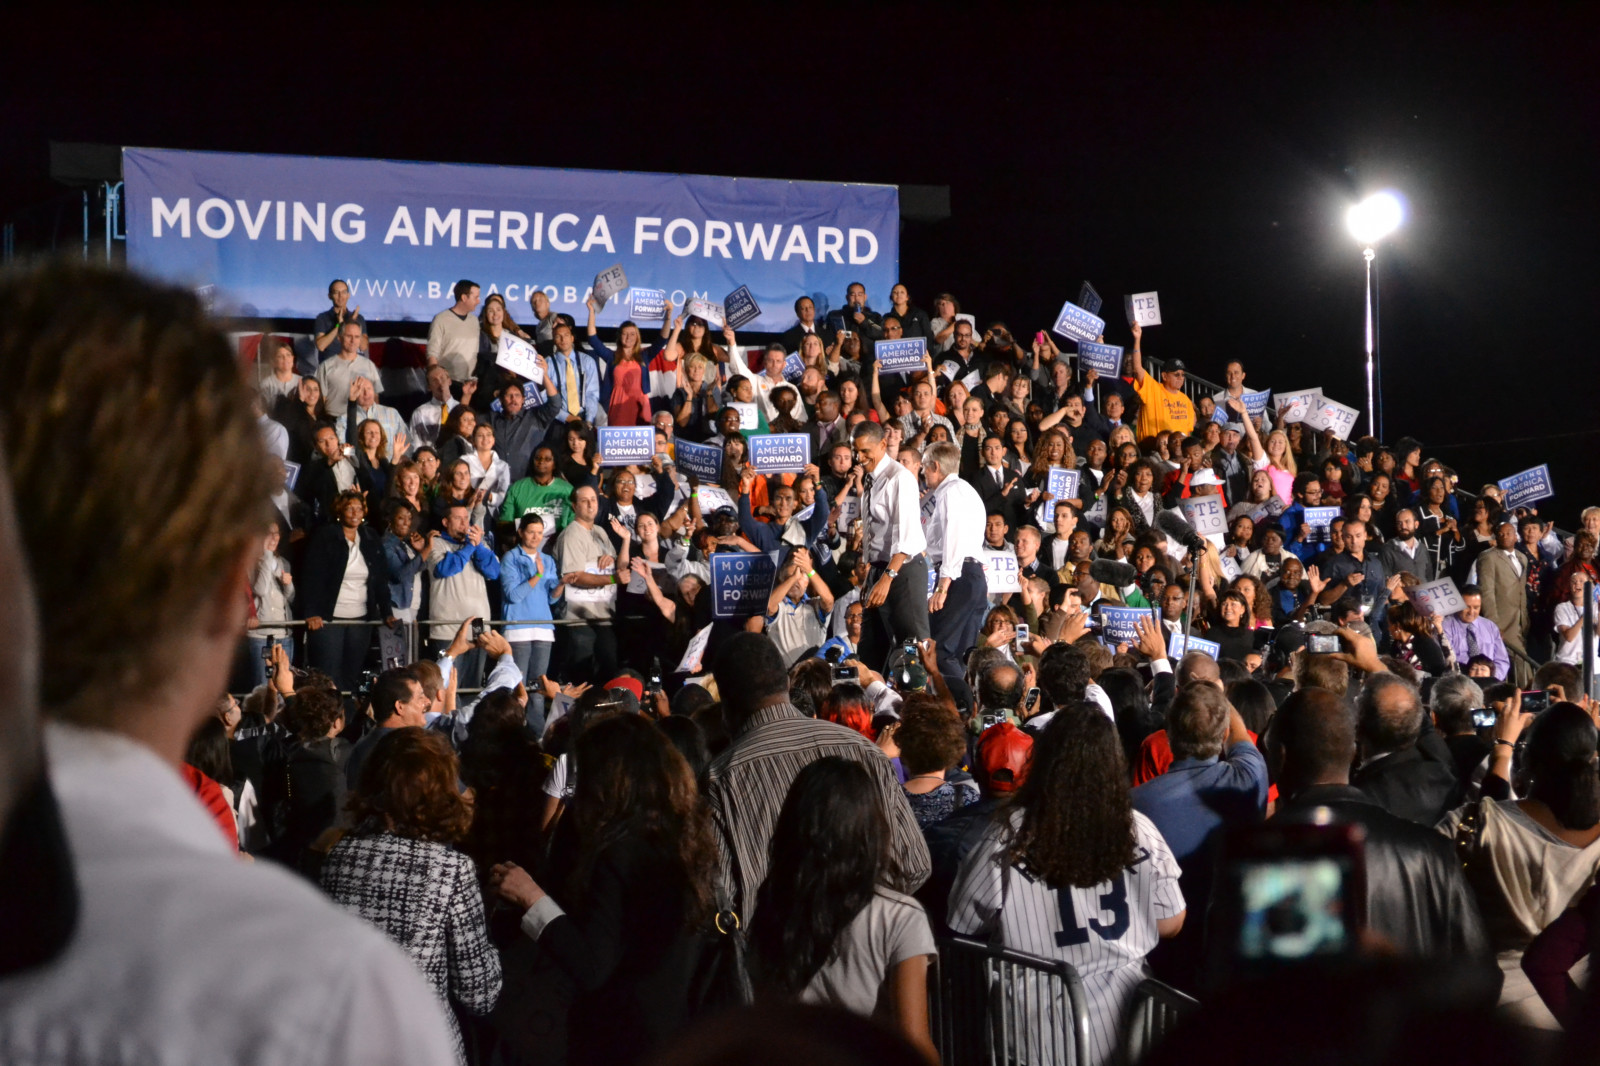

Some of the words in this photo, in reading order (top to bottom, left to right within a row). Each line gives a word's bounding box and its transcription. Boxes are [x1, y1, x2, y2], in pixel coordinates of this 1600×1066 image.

[151, 197, 366, 244] MOVING
[383, 205, 616, 254] AMERICA
[633, 216, 879, 265] FORWARD
[1134, 297, 1155, 310] TE
[728, 304, 752, 322] ORWARD
[1068, 307, 1101, 328] MOVING
[1139, 310, 1156, 321] 10
[1061, 321, 1096, 342] FORWARD
[1065, 314, 1099, 335] AMERICA
[881, 341, 920, 350] MOVING
[1081, 343, 1117, 355] MOVING
[882, 348, 920, 358] AMERICA
[1081, 351, 1116, 363] AMERICA
[882, 356, 920, 366] FORWARD
[1081, 358, 1115, 370] FORWARD
[1316, 399, 1354, 424] VOTE
[605, 430, 649, 438] MOVING
[605, 439, 649, 447] AMERICA
[756, 438, 802, 446] MOVING
[605, 447, 650, 456] FORWARD
[679, 443, 717, 457] MOVING
[756, 446, 803, 455] AMERICA
[679, 452, 716, 466] AMERICA
[756, 455, 803, 464] FORWARD
[679, 460, 716, 474] FORWARD
[1505, 470, 1542, 487] MOVING
[1508, 476, 1544, 494] AMERICA
[1064, 476, 1072, 500] WARD
[1509, 484, 1545, 502] FORWARD
[991, 557, 1016, 571] TE
[1178, 638, 1215, 654] MOVING
[1048, 873, 1130, 948] 13
